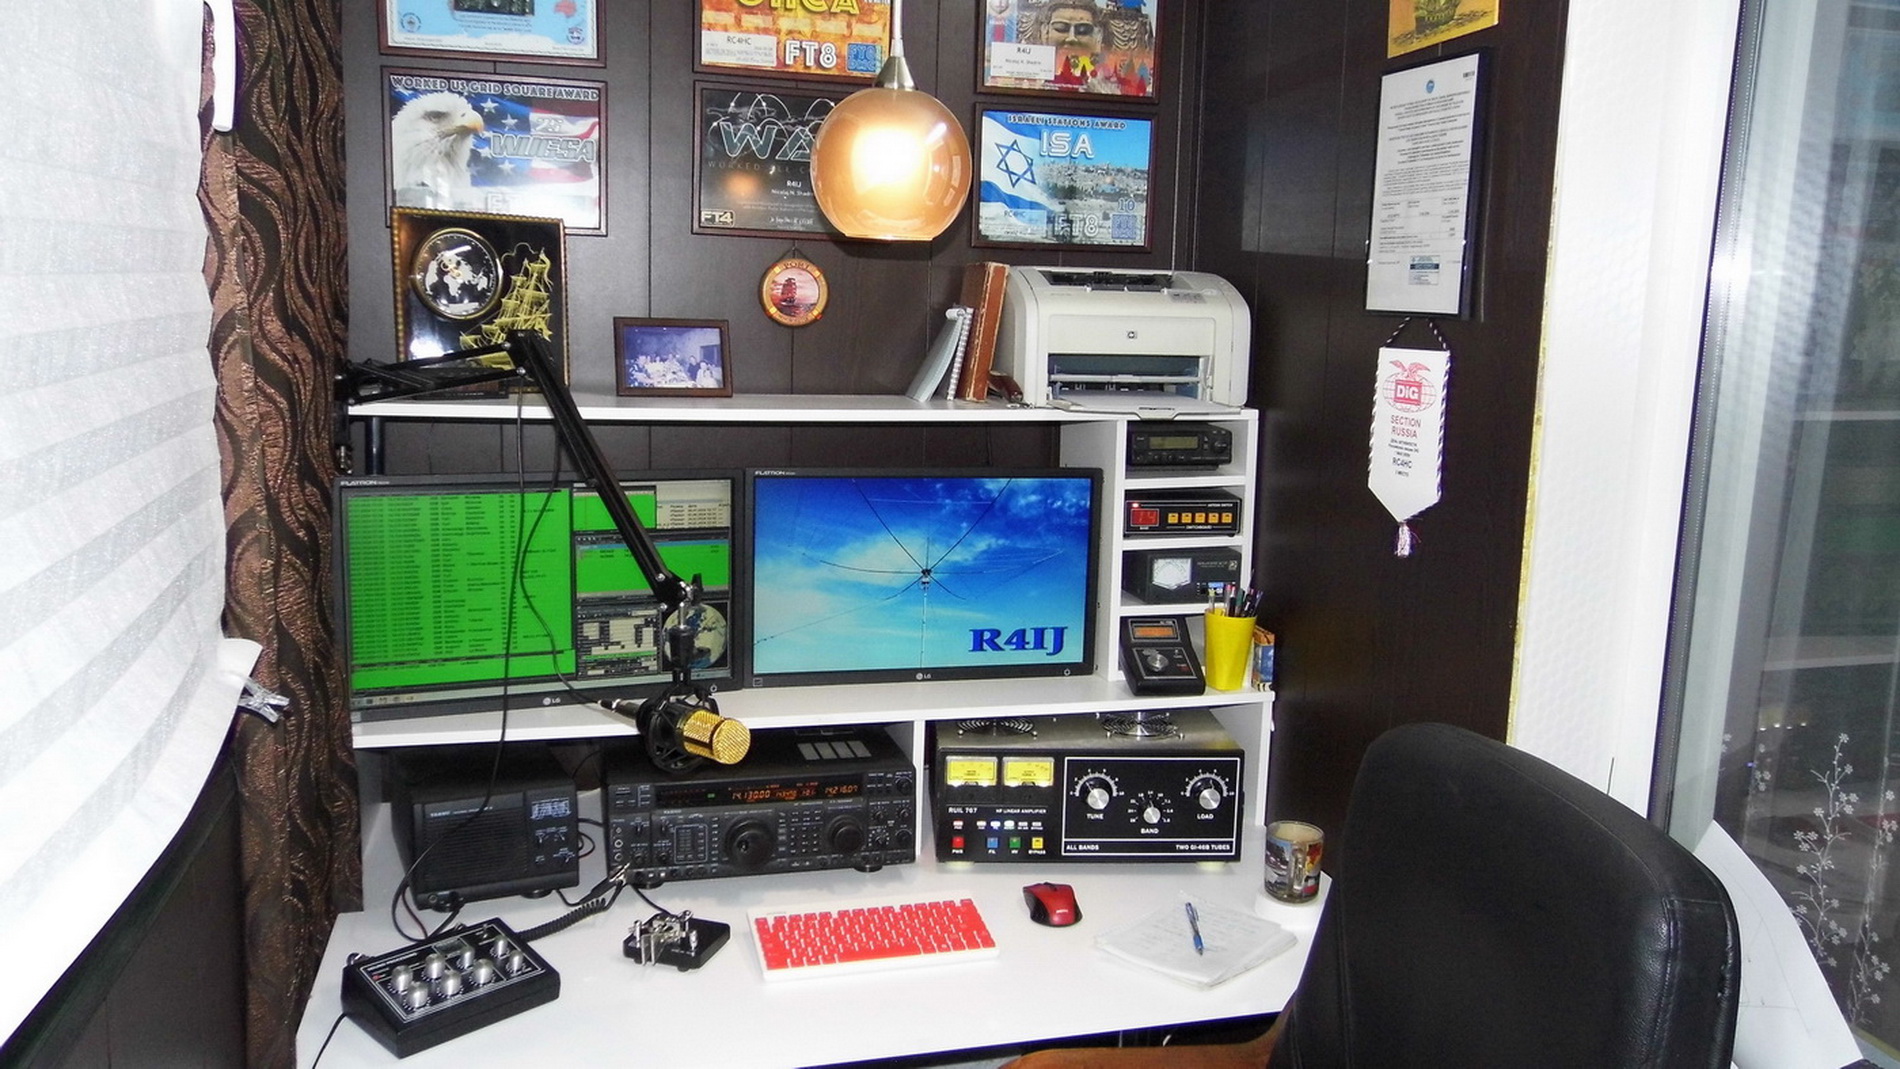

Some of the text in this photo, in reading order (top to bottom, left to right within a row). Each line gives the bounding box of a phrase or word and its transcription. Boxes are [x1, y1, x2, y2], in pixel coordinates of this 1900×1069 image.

[785, 39, 837, 68] FT8
[390, 75, 599, 101] WORKED US GRID SQUARE AWARD
[1047, 117, 1091, 128] STATIONS
[1093, 121, 1127, 130] AWARD
[1039, 128, 1095, 159] ISA
[1117, 197, 1136, 212] 10
[701, 210, 734, 225] FT4
[1053, 212, 1100, 239] FT8
[1391, 414, 1421, 427] SECTION
[1391, 425, 1418, 438] RUSSIA
[967, 626, 1068, 656] R4IJ
